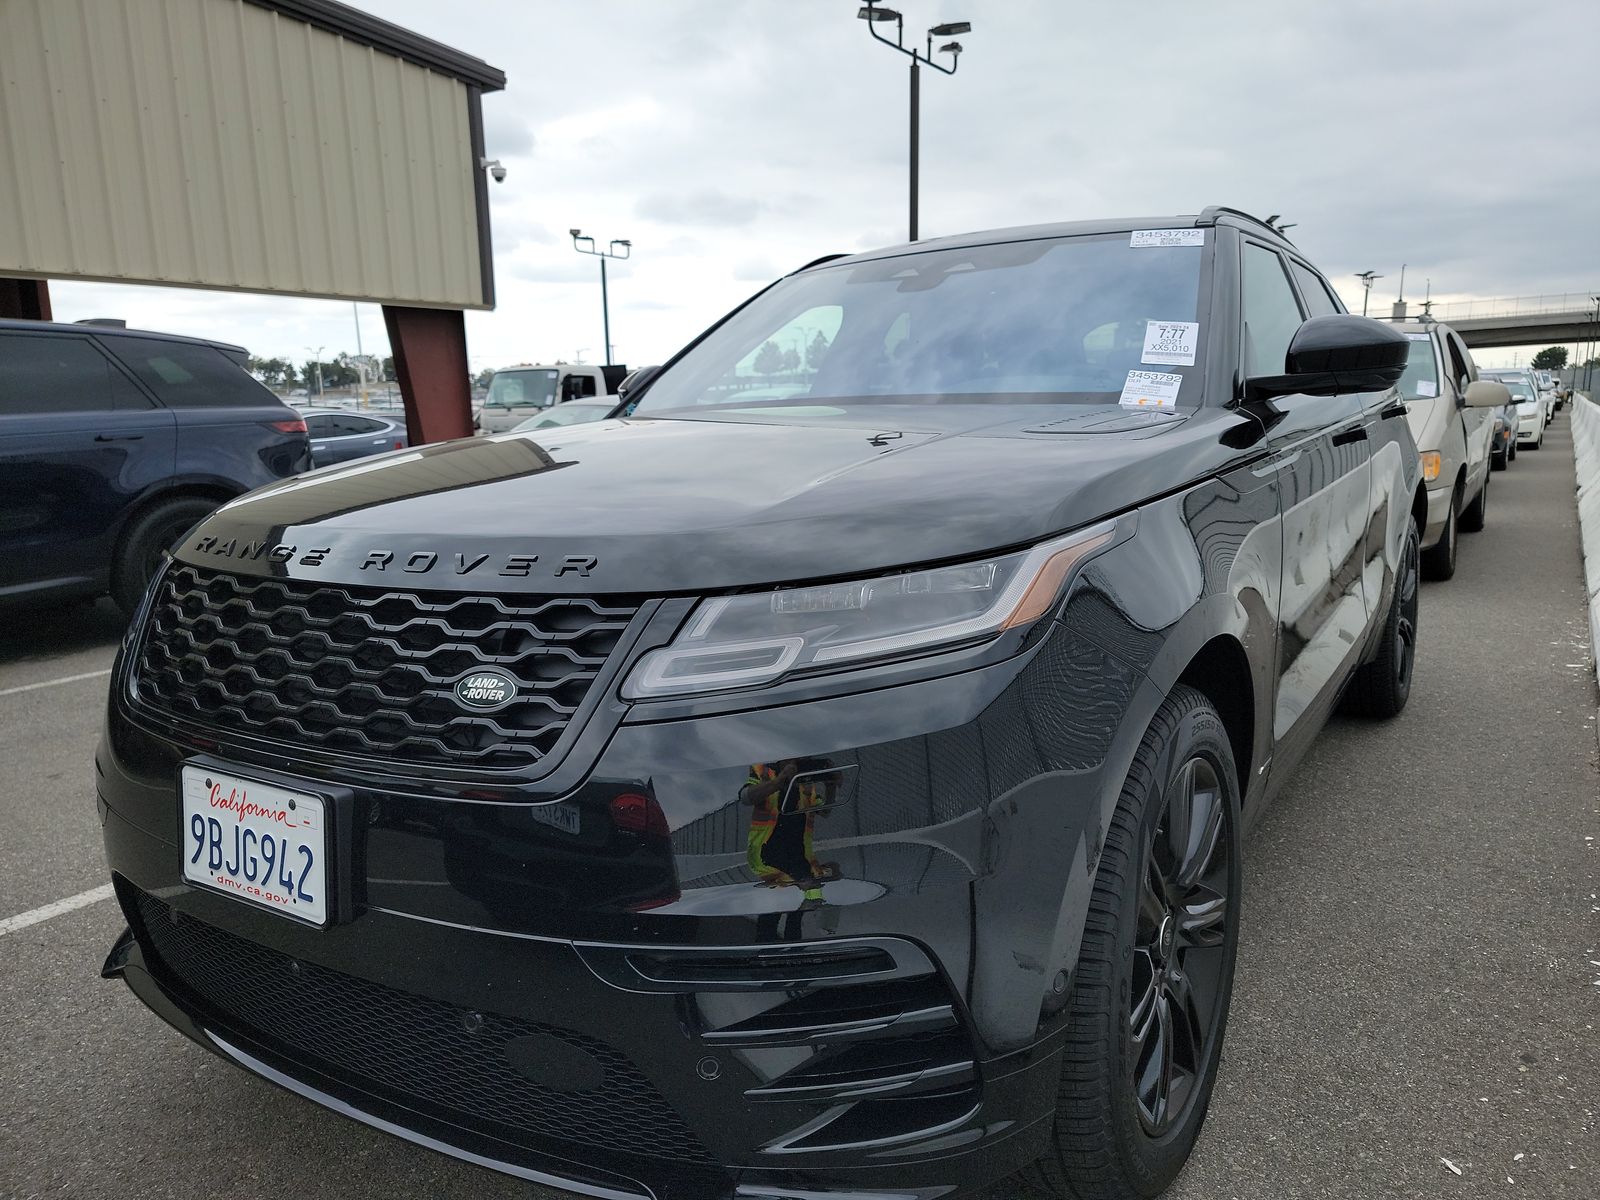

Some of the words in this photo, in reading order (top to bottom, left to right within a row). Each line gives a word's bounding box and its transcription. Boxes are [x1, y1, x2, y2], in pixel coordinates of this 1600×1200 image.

[1136, 230, 1200, 239] 3453792
[1160, 328, 1185, 338] 7:77
[1128, 371, 1181, 382] 3453792
[194, 535, 331, 566] RANGE
[359, 549, 598, 577] ROVER
[467, 678, 498, 689] LAND
[467, 688, 505, 700] ROVER
[209, 783, 298, 828] California
[191, 813, 314, 903] 9BJG942
[217, 876, 289, 905] dmv.ca.gov
